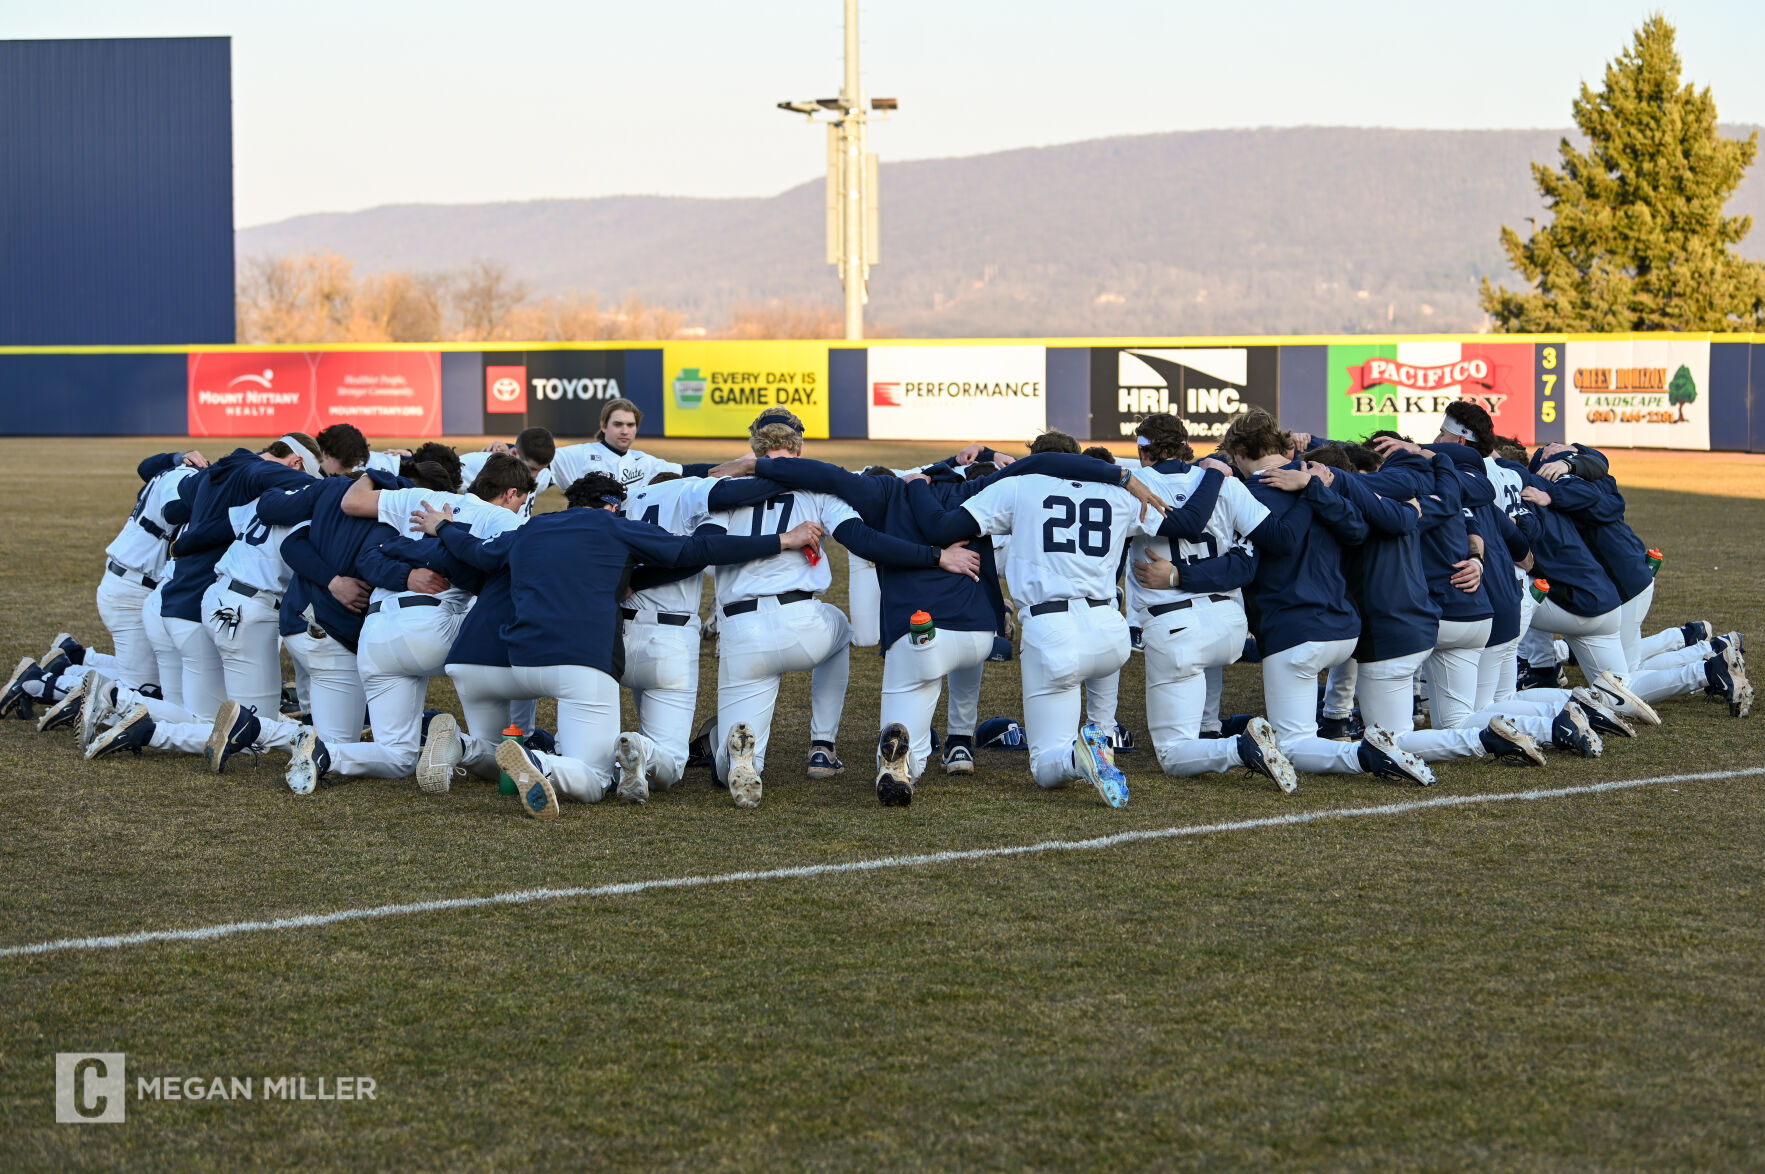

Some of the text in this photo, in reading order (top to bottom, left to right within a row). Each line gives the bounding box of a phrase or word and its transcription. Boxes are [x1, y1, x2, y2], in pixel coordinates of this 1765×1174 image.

[711, 372, 816, 384] EVERY DAY IS
[1370, 359, 1488, 387] PACIFICO
[1573, 368, 1668, 389] GREEN HORIZON
[532, 378, 621, 400] TOYOTA
[711, 387, 768, 405] GAME
[776, 387, 817, 405] DAY.
[905, 382, 1040, 397] PERFORMANCE
[1118, 388, 1248, 416] HRI, INC.
[1354, 396, 1504, 414] BAKEY
[1584, 396, 1665, 407] LANDSCAPE
[225, 406, 275, 416] HEALTH
[621, 467, 645, 483] State
[1042, 494, 1112, 557] 28
